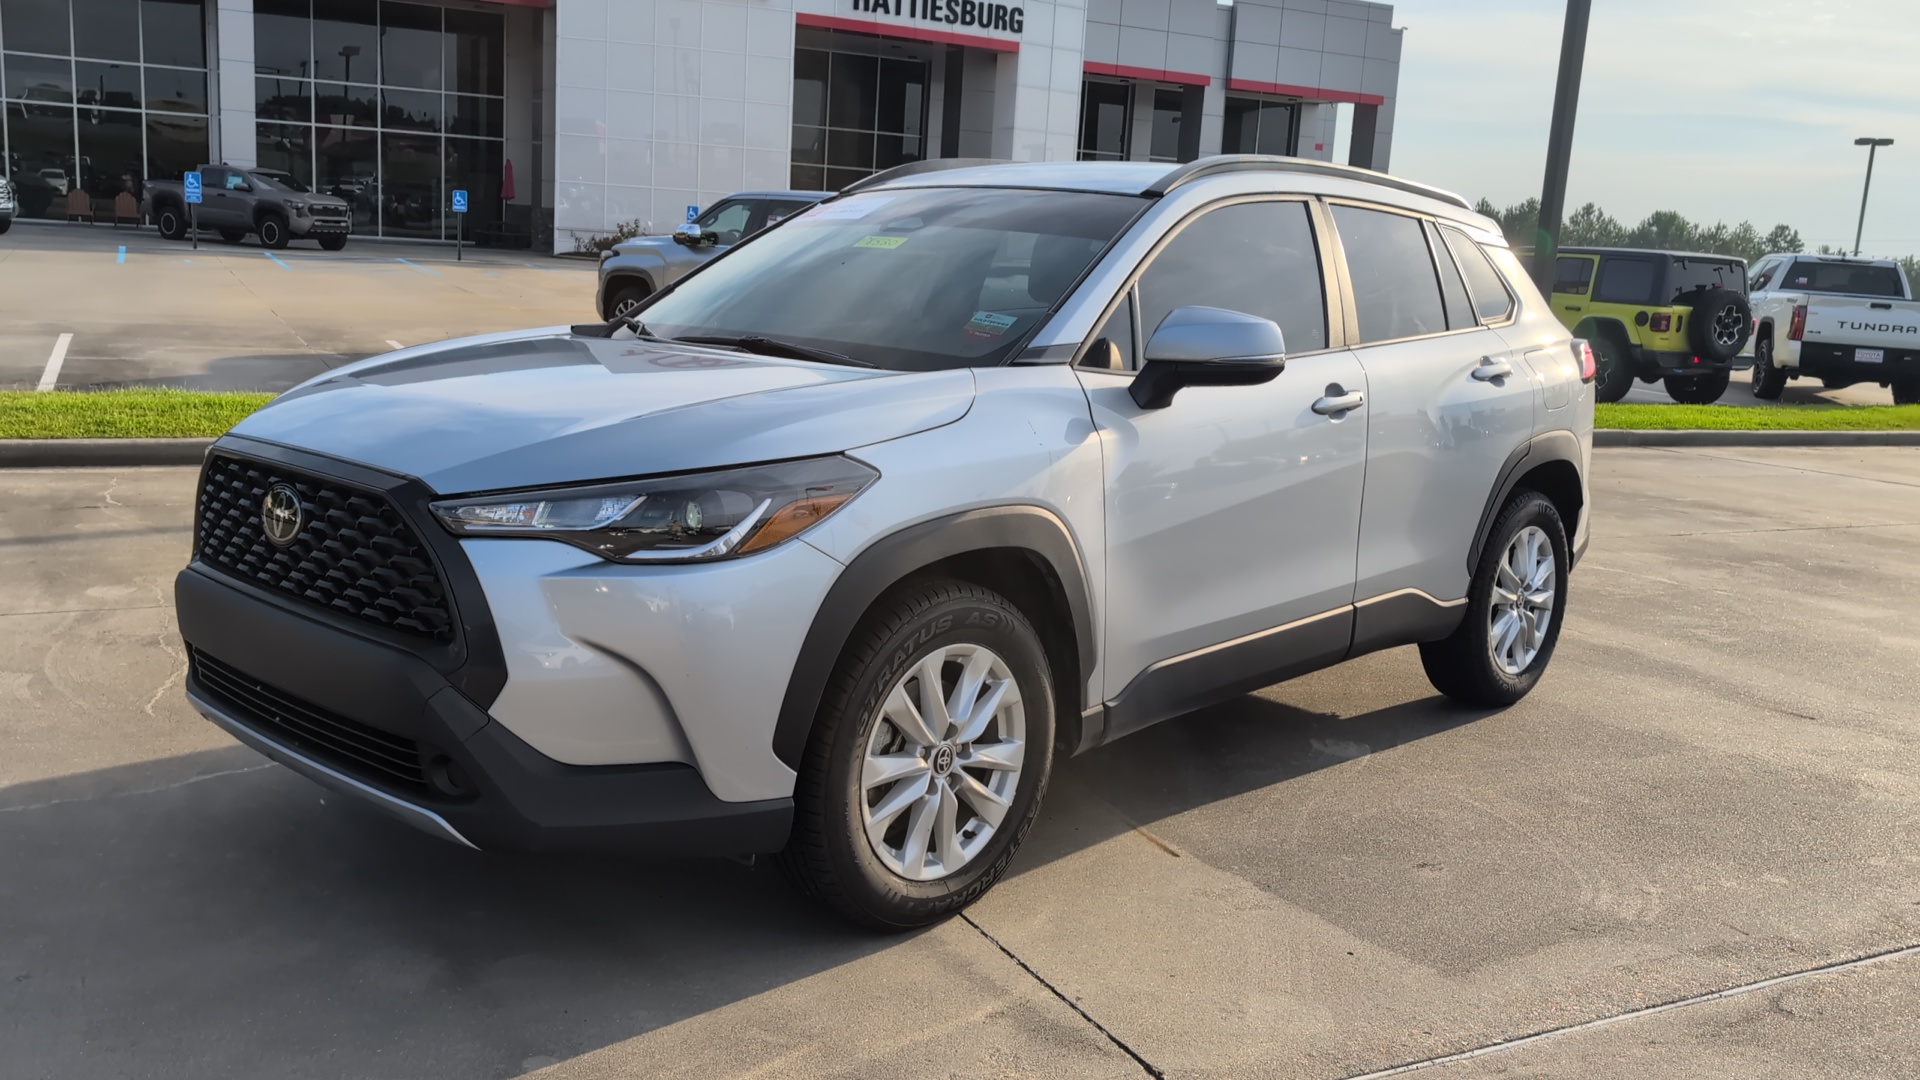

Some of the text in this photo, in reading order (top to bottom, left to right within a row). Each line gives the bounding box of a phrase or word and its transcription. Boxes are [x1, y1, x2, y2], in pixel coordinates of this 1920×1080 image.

[1837, 320, 1918, 335] TUNDRA
[857, 610, 998, 738] STRATUS AS
